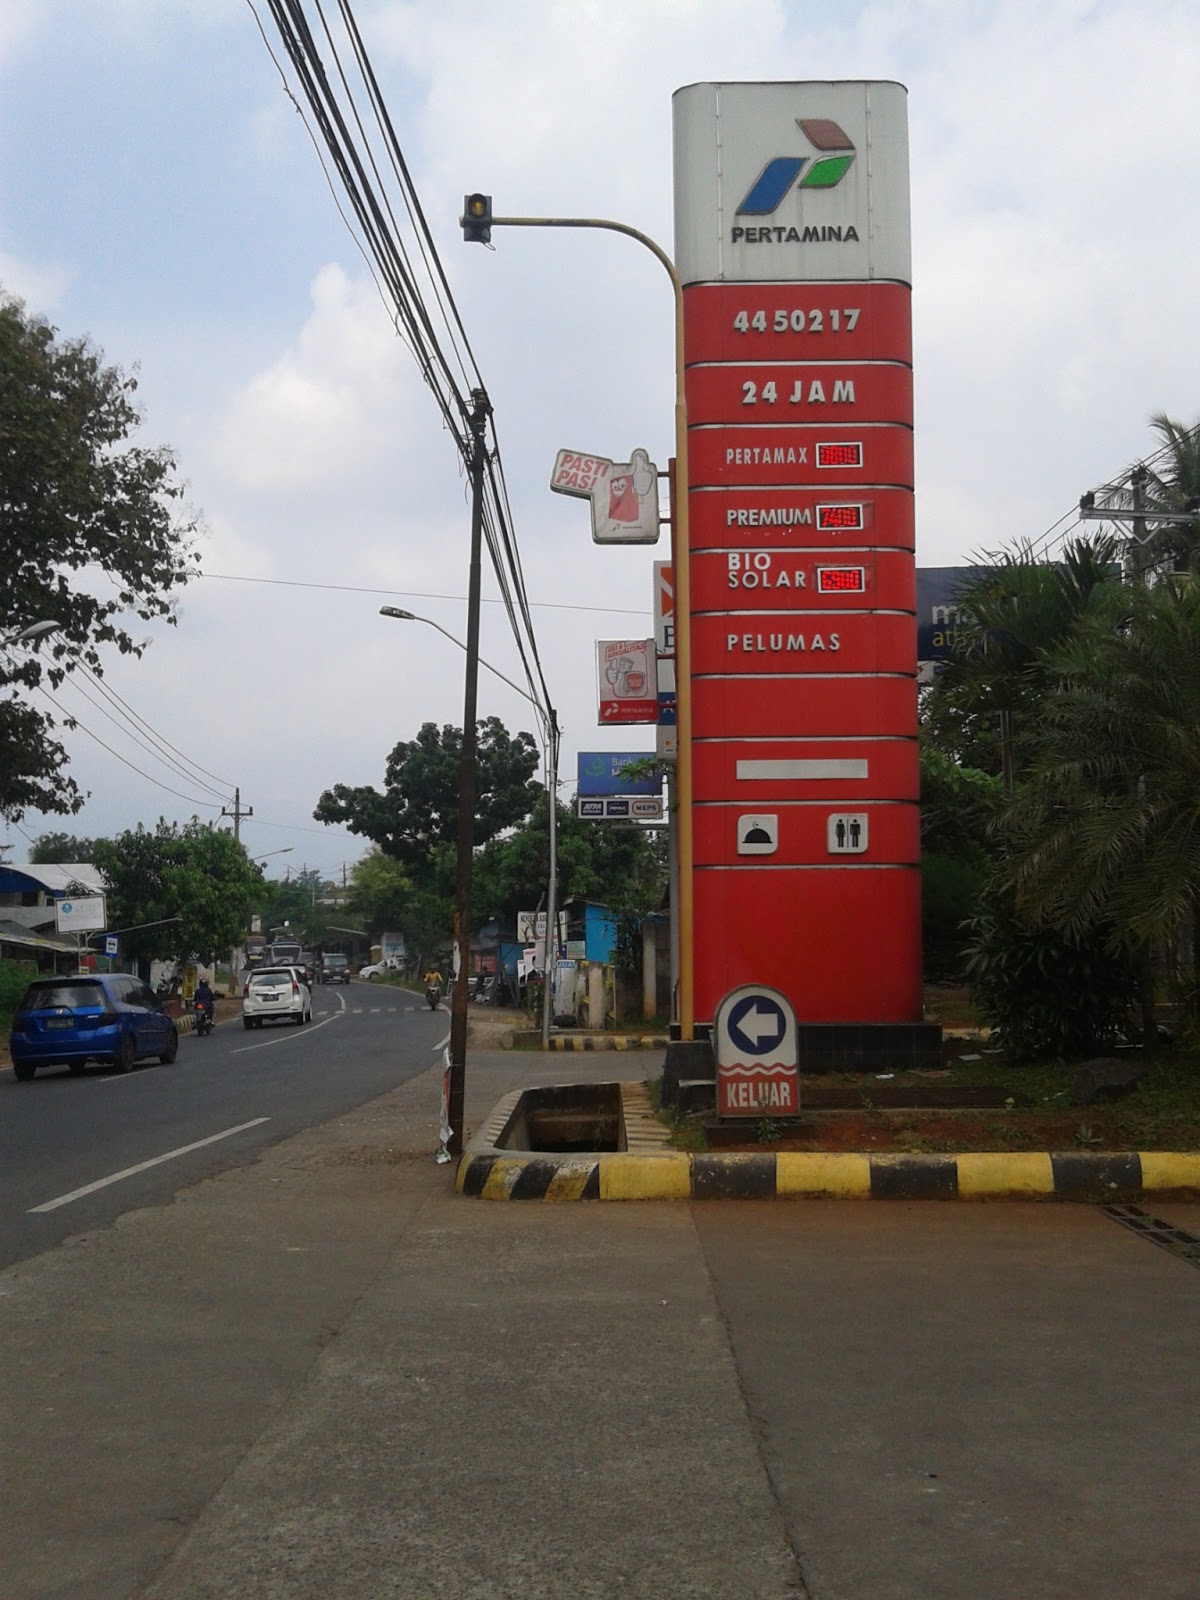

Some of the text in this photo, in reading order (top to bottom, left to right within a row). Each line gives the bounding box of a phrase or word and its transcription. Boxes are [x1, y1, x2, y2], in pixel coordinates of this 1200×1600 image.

[731, 225, 860, 243] PERTAMINA
[733, 308, 861, 333] 4450217
[742, 380, 856, 404] 24 JAM
[726, 447, 808, 464] PERTAMAX
[560, 454, 610, 477] PASTI
[555, 470, 598, 491] PAS!
[727, 507, 857, 528] PREMIUM 7400
[728, 553, 771, 571] BIO
[728, 571, 807, 589] SOLAR
[727, 633, 841, 651] PELUMAS
[611, 757, 634, 766] Bank
[726, 1081, 792, 1108] KELUAR
